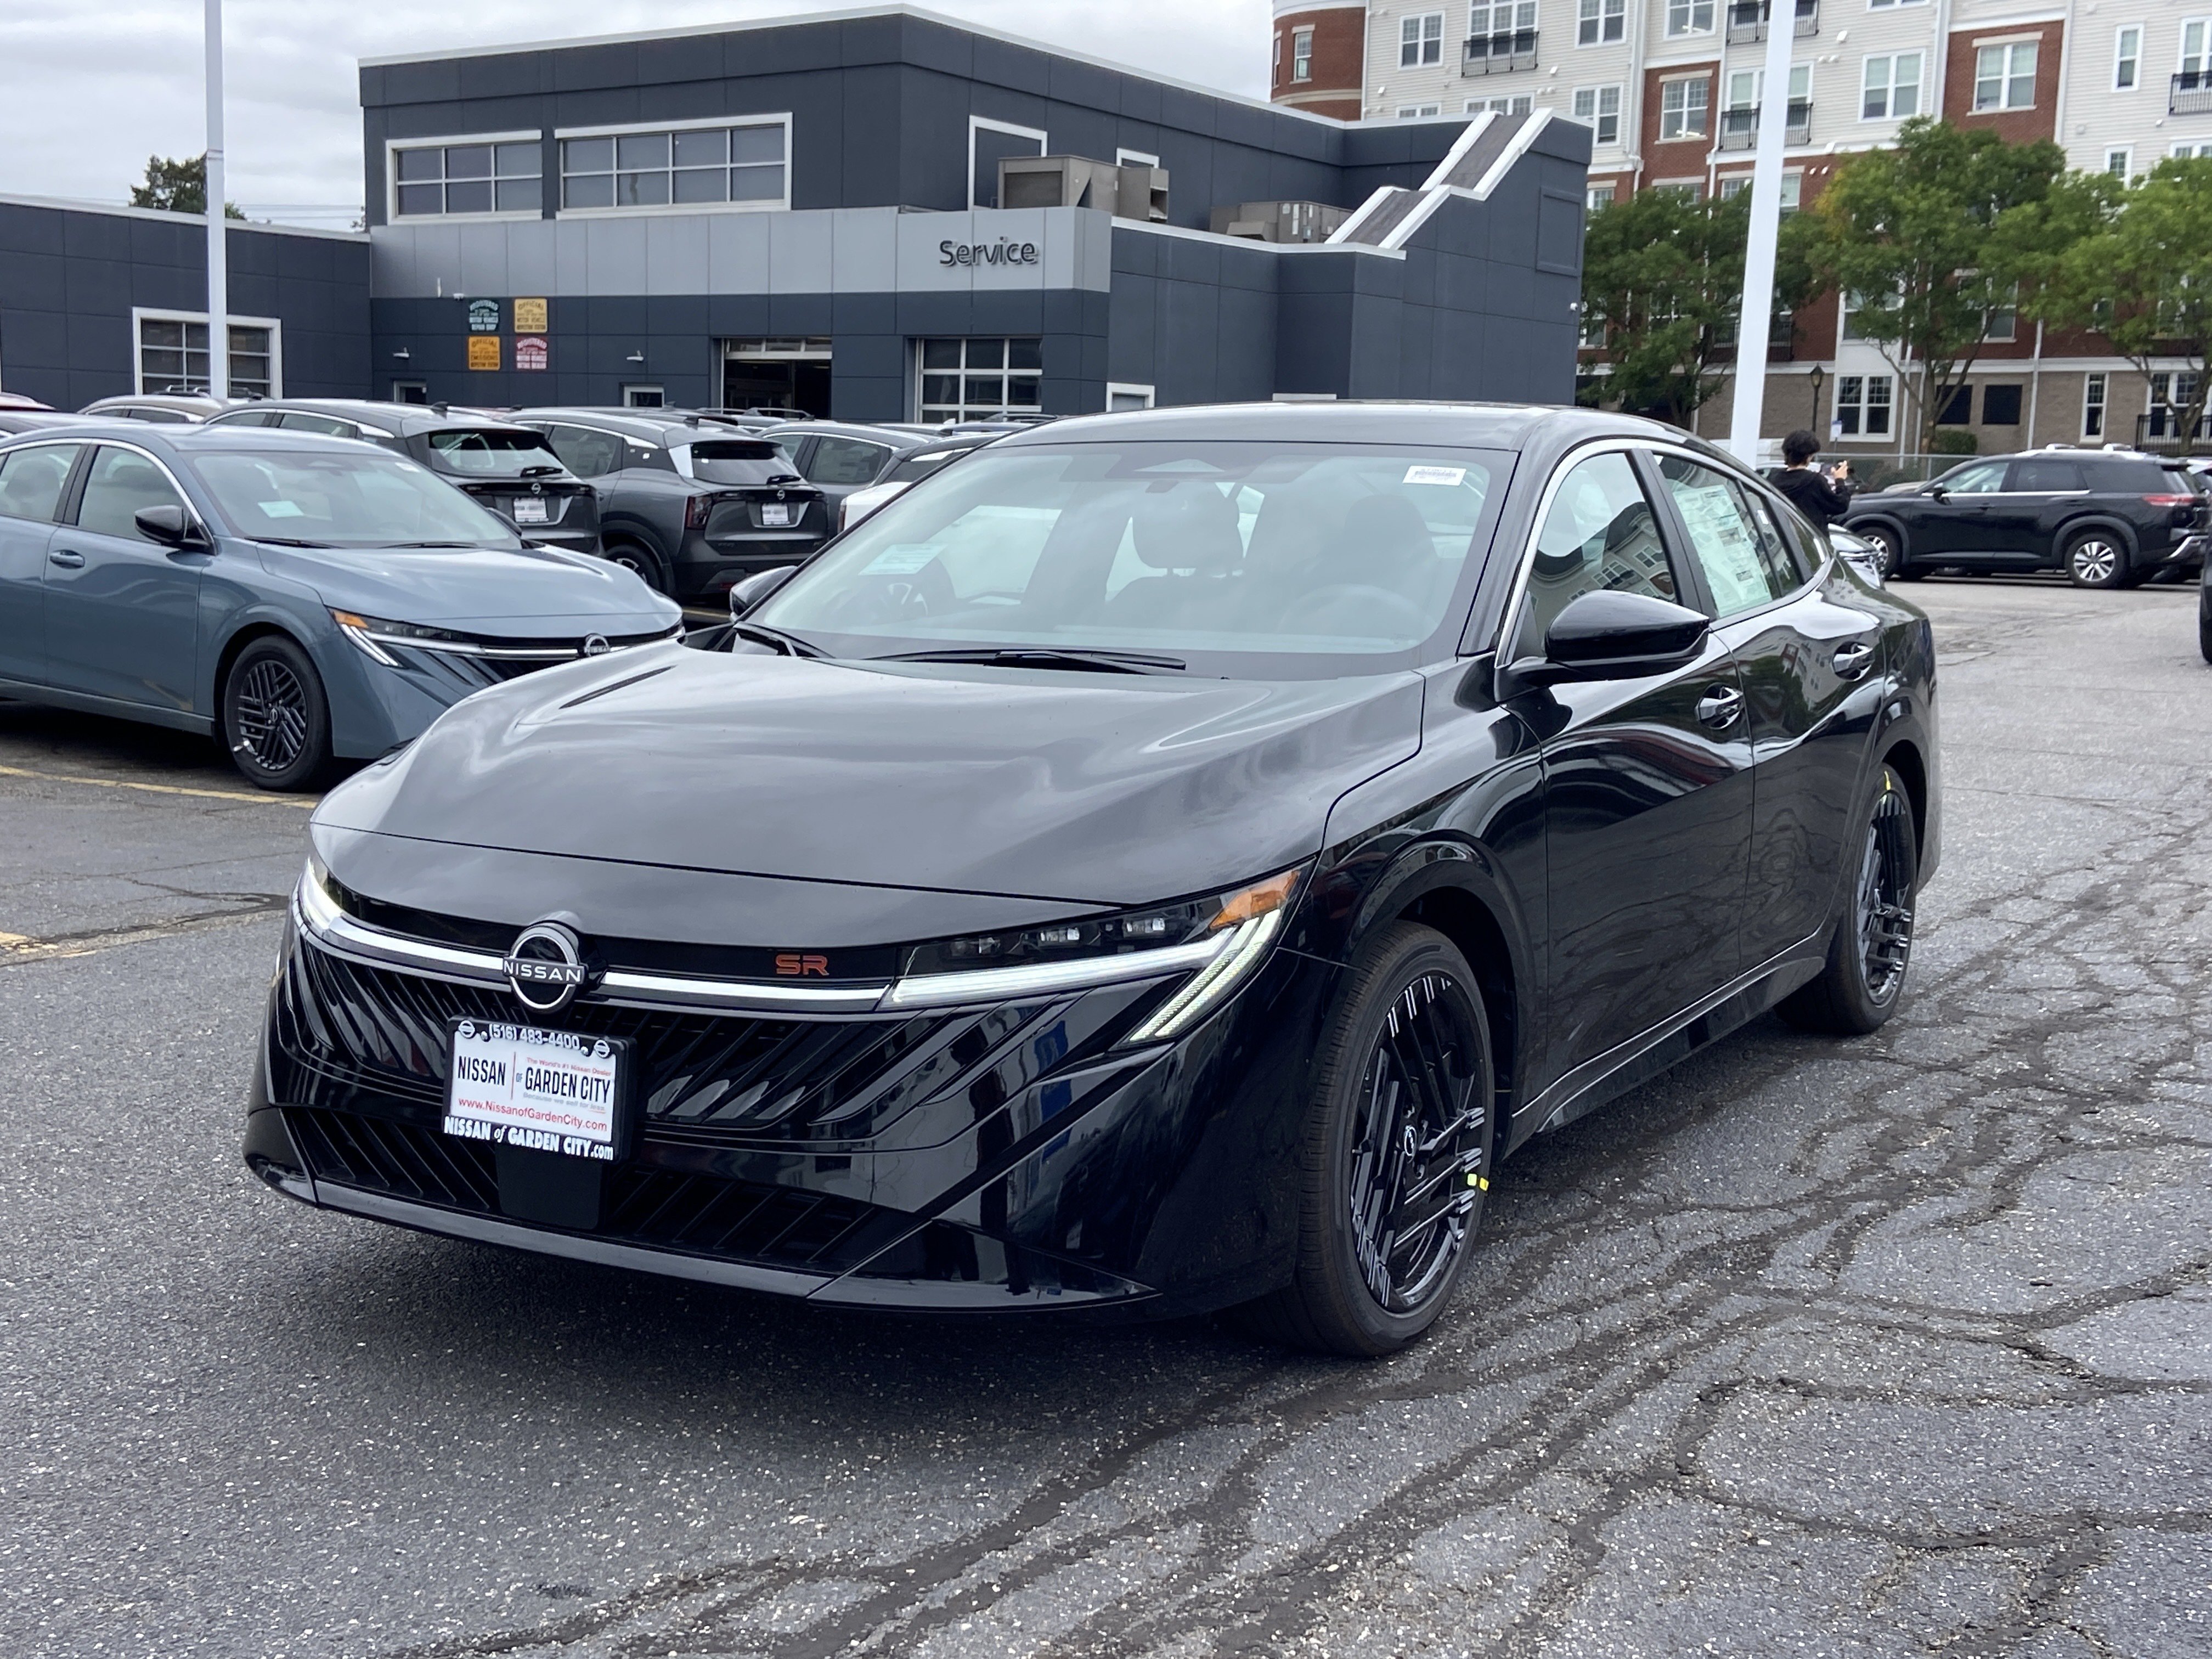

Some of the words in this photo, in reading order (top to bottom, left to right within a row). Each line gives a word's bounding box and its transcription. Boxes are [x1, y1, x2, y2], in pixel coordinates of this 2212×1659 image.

[939, 236, 1037, 266] Service
[504, 960, 581, 982] NISSAN
[775, 954, 830, 976] SR
[489, 1024, 517, 1041] (516)
[520, 1028, 580, 1050] 483-4400
[458, 1056, 506, 1086] NISSAN
[525, 1066, 577, 1098] GARDEN
[580, 1075, 611, 1103] CITY
[459, 1098, 607, 1132] www.NissanofGardenCity.com
[444, 1116, 492, 1141] NISSAN
[494, 1125, 507, 1143] of
[508, 1127, 560, 1152] GARDEN
[563, 1136, 613, 1161] CITY.com
